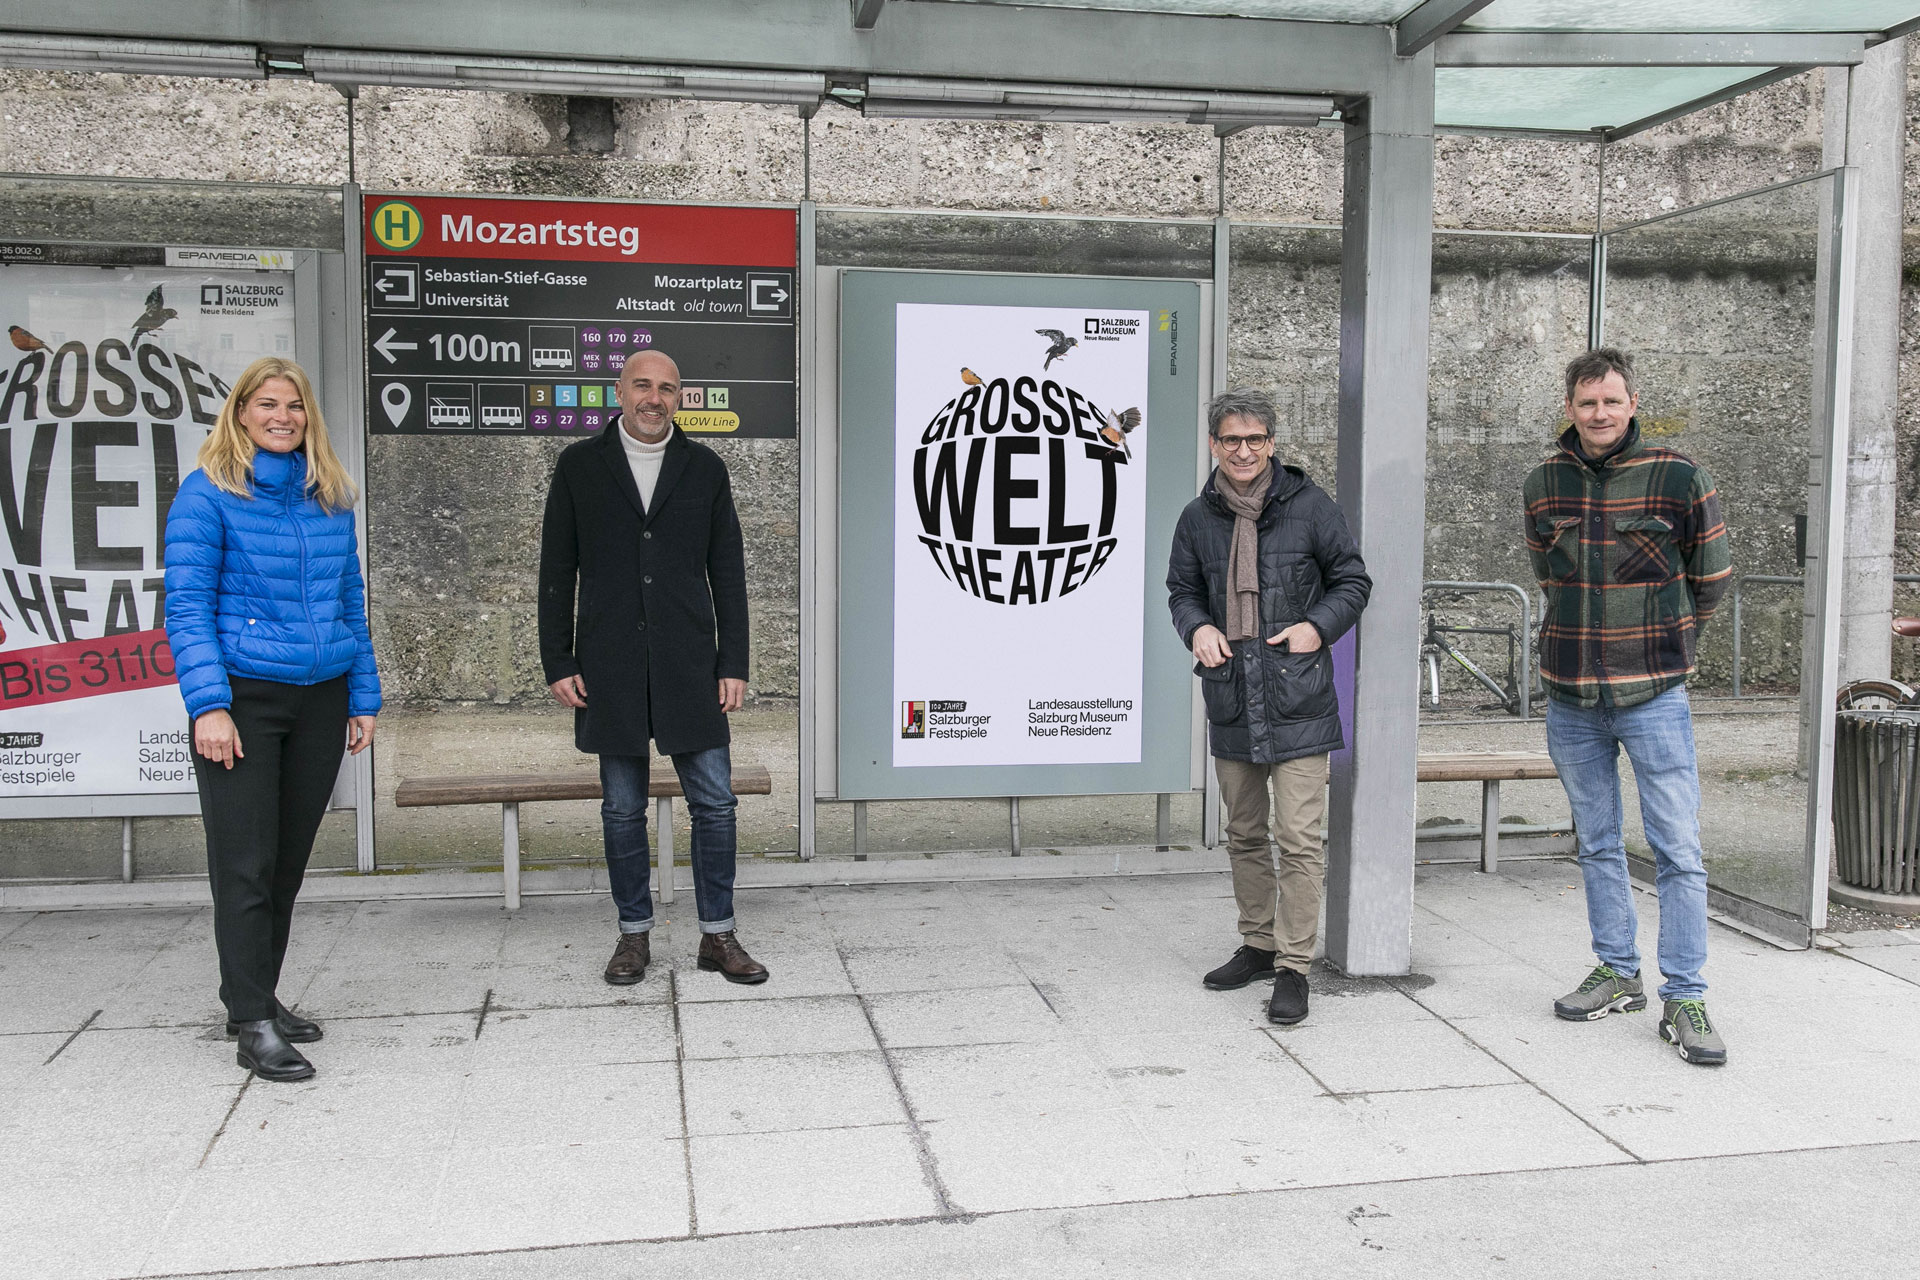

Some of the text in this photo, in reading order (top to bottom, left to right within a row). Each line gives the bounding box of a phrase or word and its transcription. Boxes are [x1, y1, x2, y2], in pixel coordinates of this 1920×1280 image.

[384, 209, 410, 241] H
[441, 214, 639, 255] Mozartsteg
[0, 246, 41, 255] 36 002-0
[178, 251, 257, 261] EPAMEDIA
[425, 268, 588, 286] Sebastian-Stief-Gasse
[654, 275, 743, 292] Mozartplatz
[225, 285, 284, 295] SALZBURG
[226, 297, 279, 307] MUSEUM
[425, 292, 510, 308] Universität
[616, 297, 743, 313] Altstadt old town
[200, 307, 255, 316] Neue Residenz
[1101, 318, 1140, 327] SALZBURG
[1101, 327, 1136, 335] MUSEUM
[582, 332, 652, 344] 160 170 270
[1170, 310, 1178, 376] EPAMEDIA
[428, 333, 521, 363] 100m
[583, 354, 600, 362] MEX
[608, 354, 626, 363] MEX
[585, 361, 599, 369] 120
[536, 390, 597, 403] 3 5 6
[686, 392, 726, 404] 10 14
[920, 375, 1117, 446] GROSSES
[534, 415, 548, 424] 25
[560, 415, 573, 425] 27
[585, 415, 599, 425] 28
[672, 416, 736, 426] ELLOW Line
[913, 436, 1128, 546] WELT
[917, 534, 1118, 606] THEATER
[0, 658, 71, 701] Bis
[943, 702, 965, 711] JAHRE
[1028, 698, 1133, 710] Landesausstellung
[928, 713, 991, 726] Salzburger
[1028, 711, 1128, 724] Salzburg Museum
[139, 729, 190, 744] Lande
[929, 727, 988, 740] Festspiele
[1028, 724, 1112, 737] Neue Residenz
[6, 734, 40, 746] JAHRE
[0, 750, 82, 767] alzburger
[138, 747, 193, 763] Salzbu
[139, 767, 184, 781] Neue
